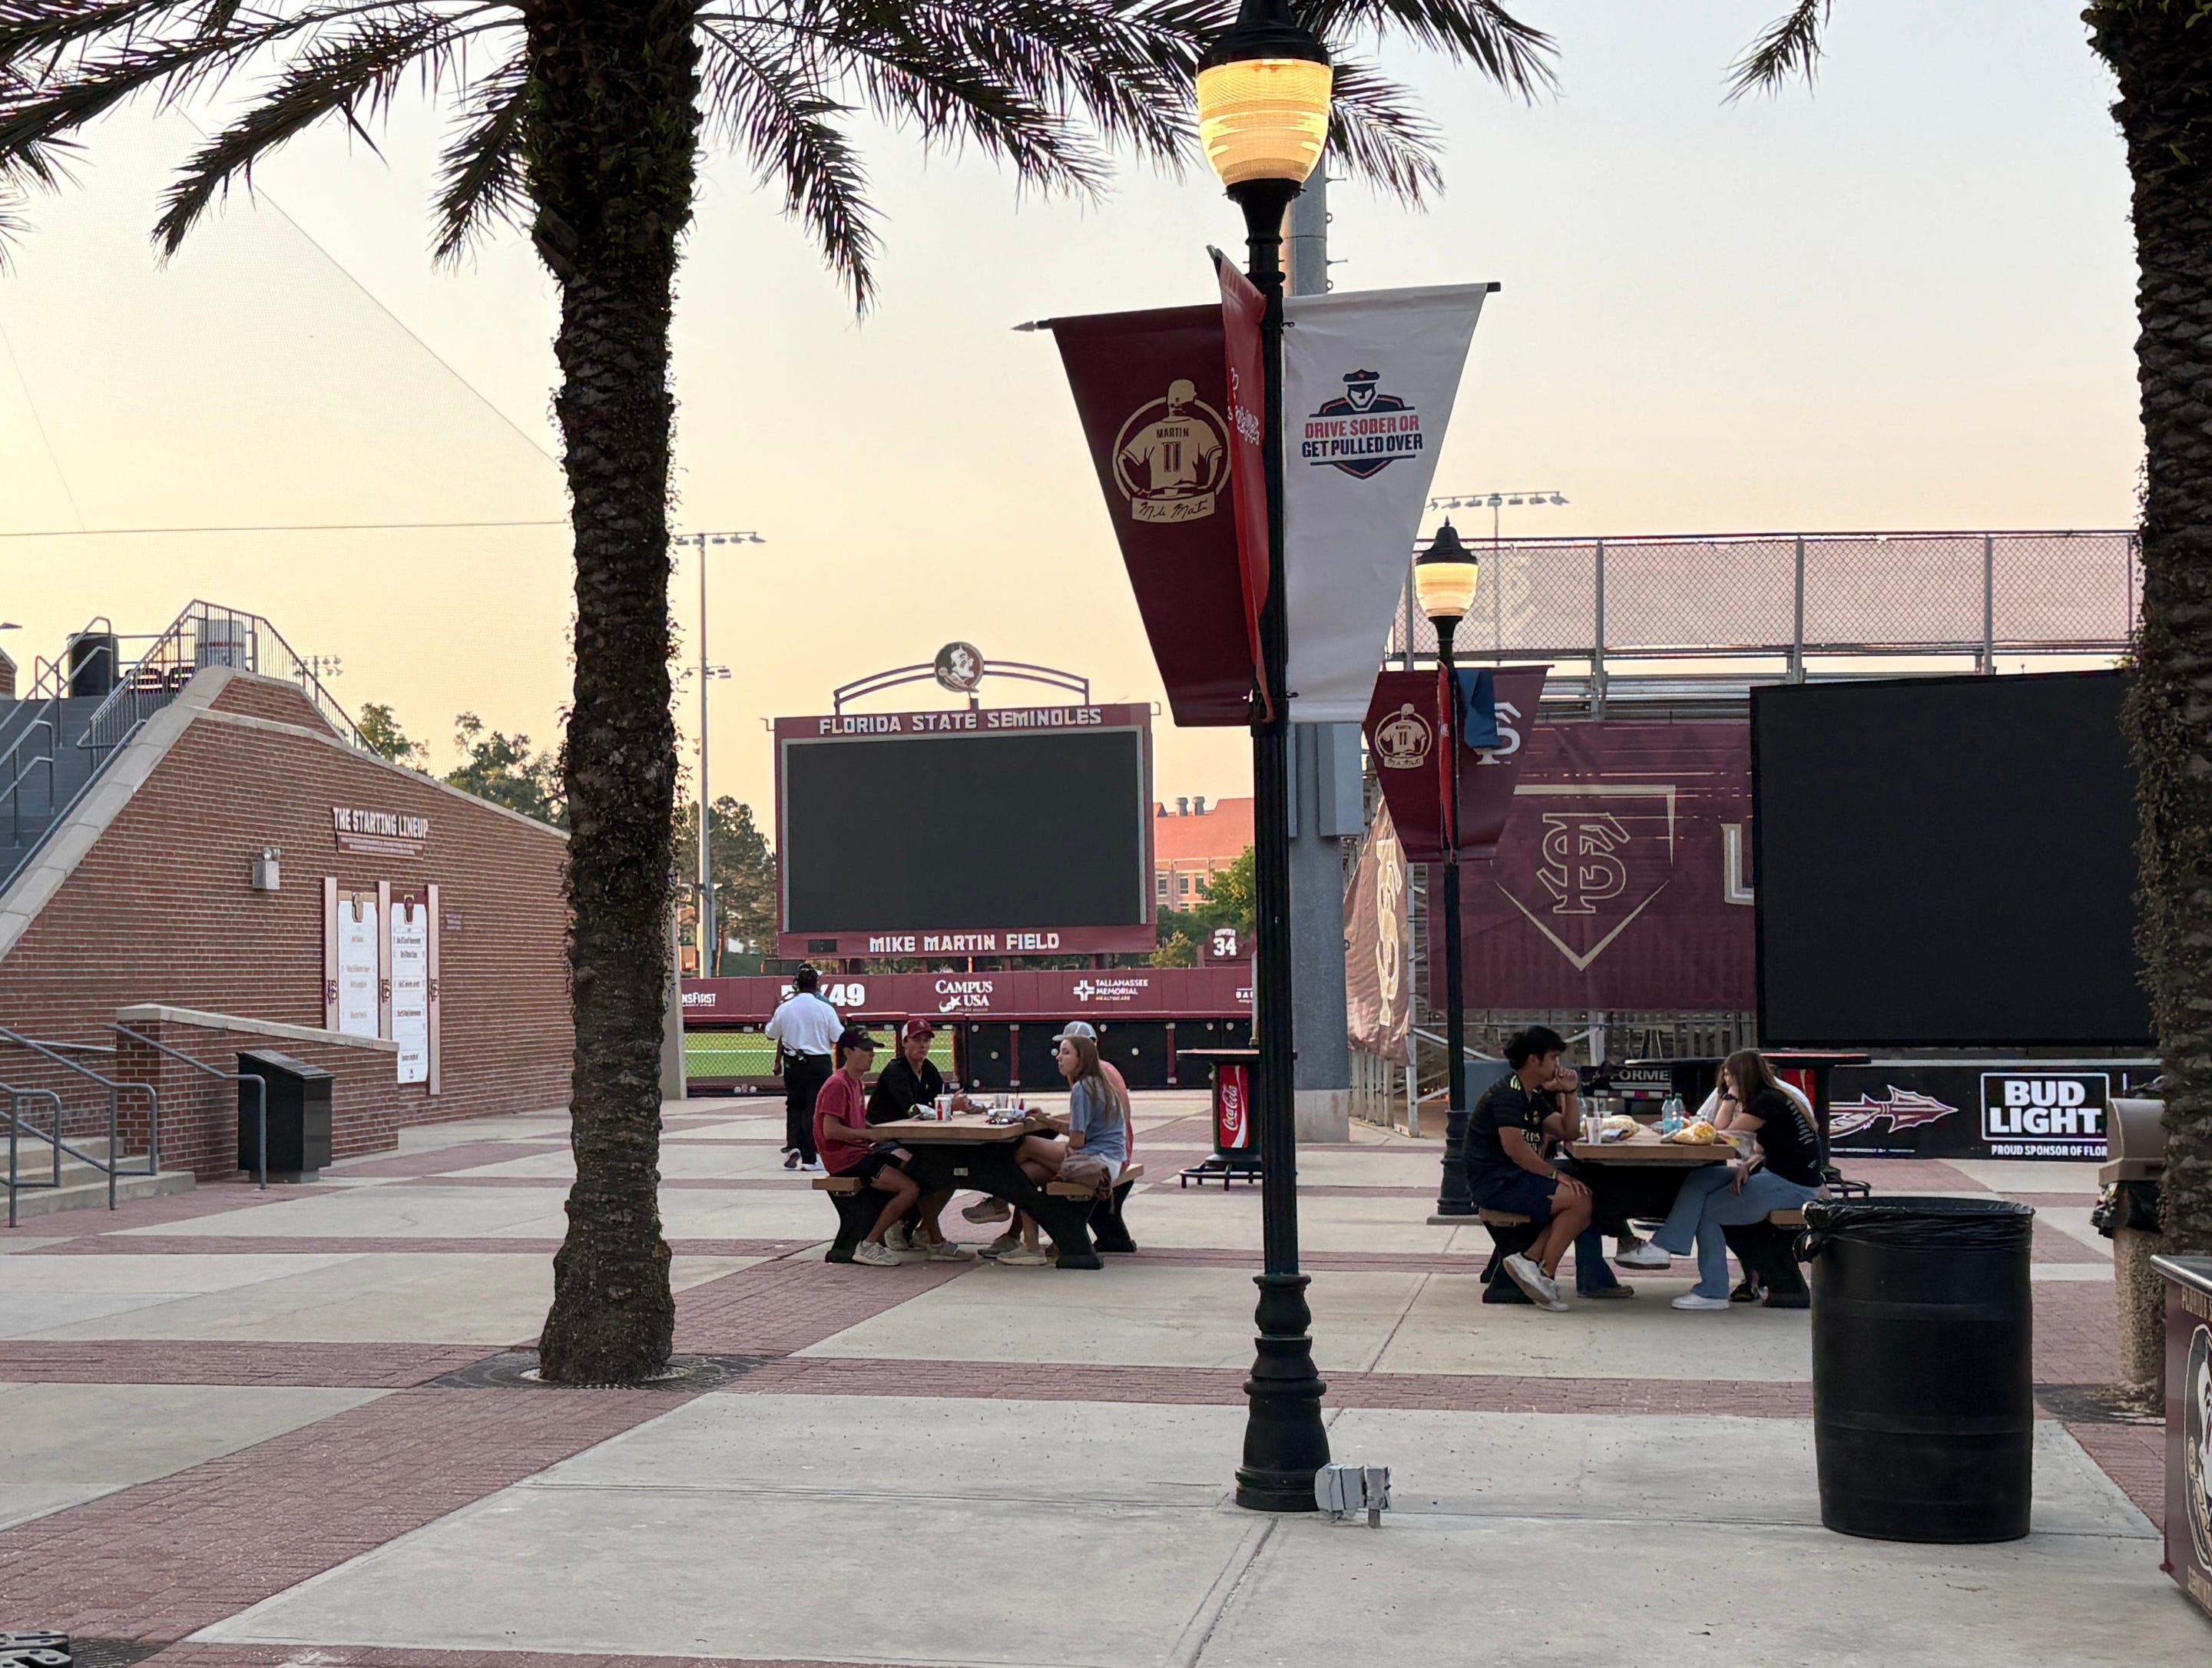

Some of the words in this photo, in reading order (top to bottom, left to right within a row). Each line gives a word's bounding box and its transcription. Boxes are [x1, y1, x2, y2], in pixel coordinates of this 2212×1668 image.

[1156, 427, 1190, 439] MARTIN
[1304, 420, 1347, 439] DRIVE
[1349, 417, 1396, 436] SOBER
[1399, 415, 1419, 432] OR
[1161, 441, 1181, 472] 11
[1301, 440, 1330, 458] GET
[1330, 436, 1384, 456] PULLED
[1386, 433, 1423, 452] OVER
[819, 714, 902, 735] FLORIDA
[912, 713, 978, 731] STATE
[987, 708, 1102, 729] SEMINOLES
[333, 806, 352, 830] THE
[353, 809, 397, 836] STARTING
[399, 815, 429, 839] LINEUP
[869, 935, 916, 953] MIKE
[924, 934, 996, 951] MARTIN
[1005, 932, 1060, 951] FIELD
[1213, 936, 1237, 956] 34
[935, 979, 994, 994] CAMPUS
[963, 995, 990, 1006] USA
[2004, 1080, 2086, 1107] BUD
[1989, 1107, 2102, 1134] LIGHT
[1991, 1144, 2024, 1156] PROUD
[2024, 1145, 2068, 1156] SPONSOR
[2070, 1146, 2082, 1157] OF
